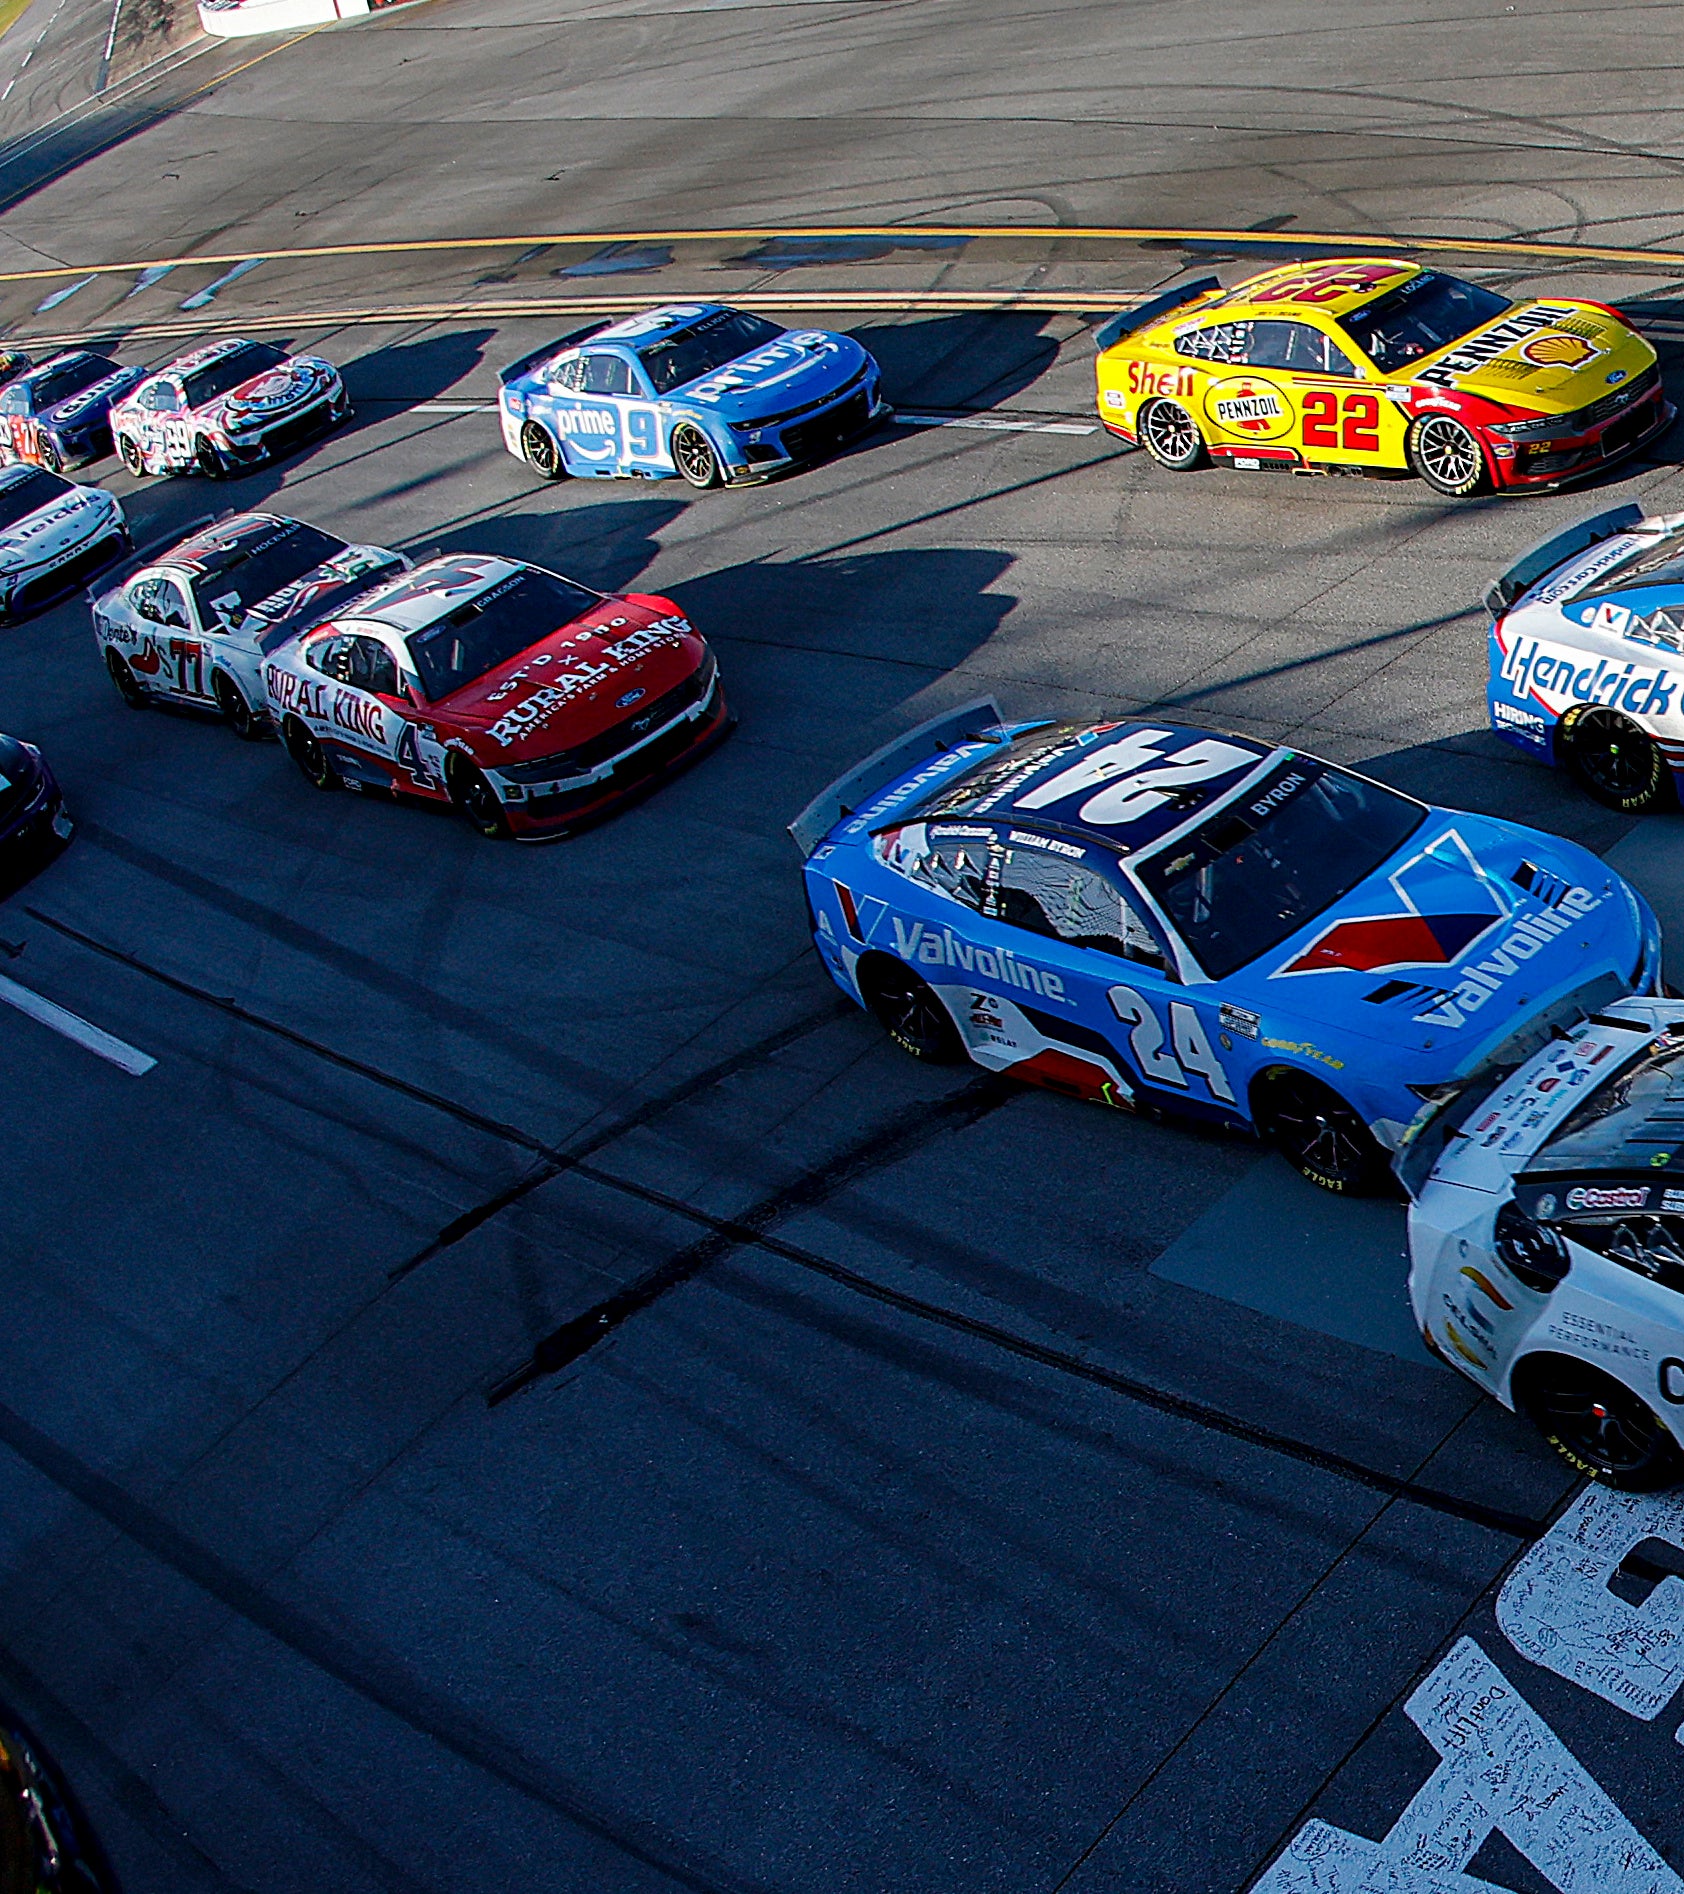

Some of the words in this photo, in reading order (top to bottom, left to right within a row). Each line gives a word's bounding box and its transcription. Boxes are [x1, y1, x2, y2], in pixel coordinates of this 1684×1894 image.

[685, 331, 838, 404] prime
[1128, 360, 1195, 397] Shell
[1413, 305, 1580, 388] PENNZOIL
[556, 402, 616, 441] prime
[628, 408, 658, 458] 9
[1217, 396, 1281, 420] PENNZOIL
[1302, 391, 1380, 451] 22
[169, 636, 206, 697] 77
[485, 660, 611, 748] RURAL
[601, 615, 693, 663] KING
[486, 652, 554, 703] EST'D
[519, 693, 576, 741] AMERICA'S
[619, 646, 652, 667] HOME
[266, 662, 329, 721] RURAL
[334, 688, 389, 745] KING
[1493, 701, 1546, 735] HIRING
[399, 721, 443, 790] 4
[843, 740, 990, 835] Valvoline
[1012, 729, 1264, 825] 24
[1250, 772, 1307, 817] BYRON
[890, 916, 1068, 1004] Valvoline
[1410, 885, 1598, 1029] Valvoline
[1107, 985, 1237, 1105] 24
[1546, 1435, 1597, 1479] EAGLE
